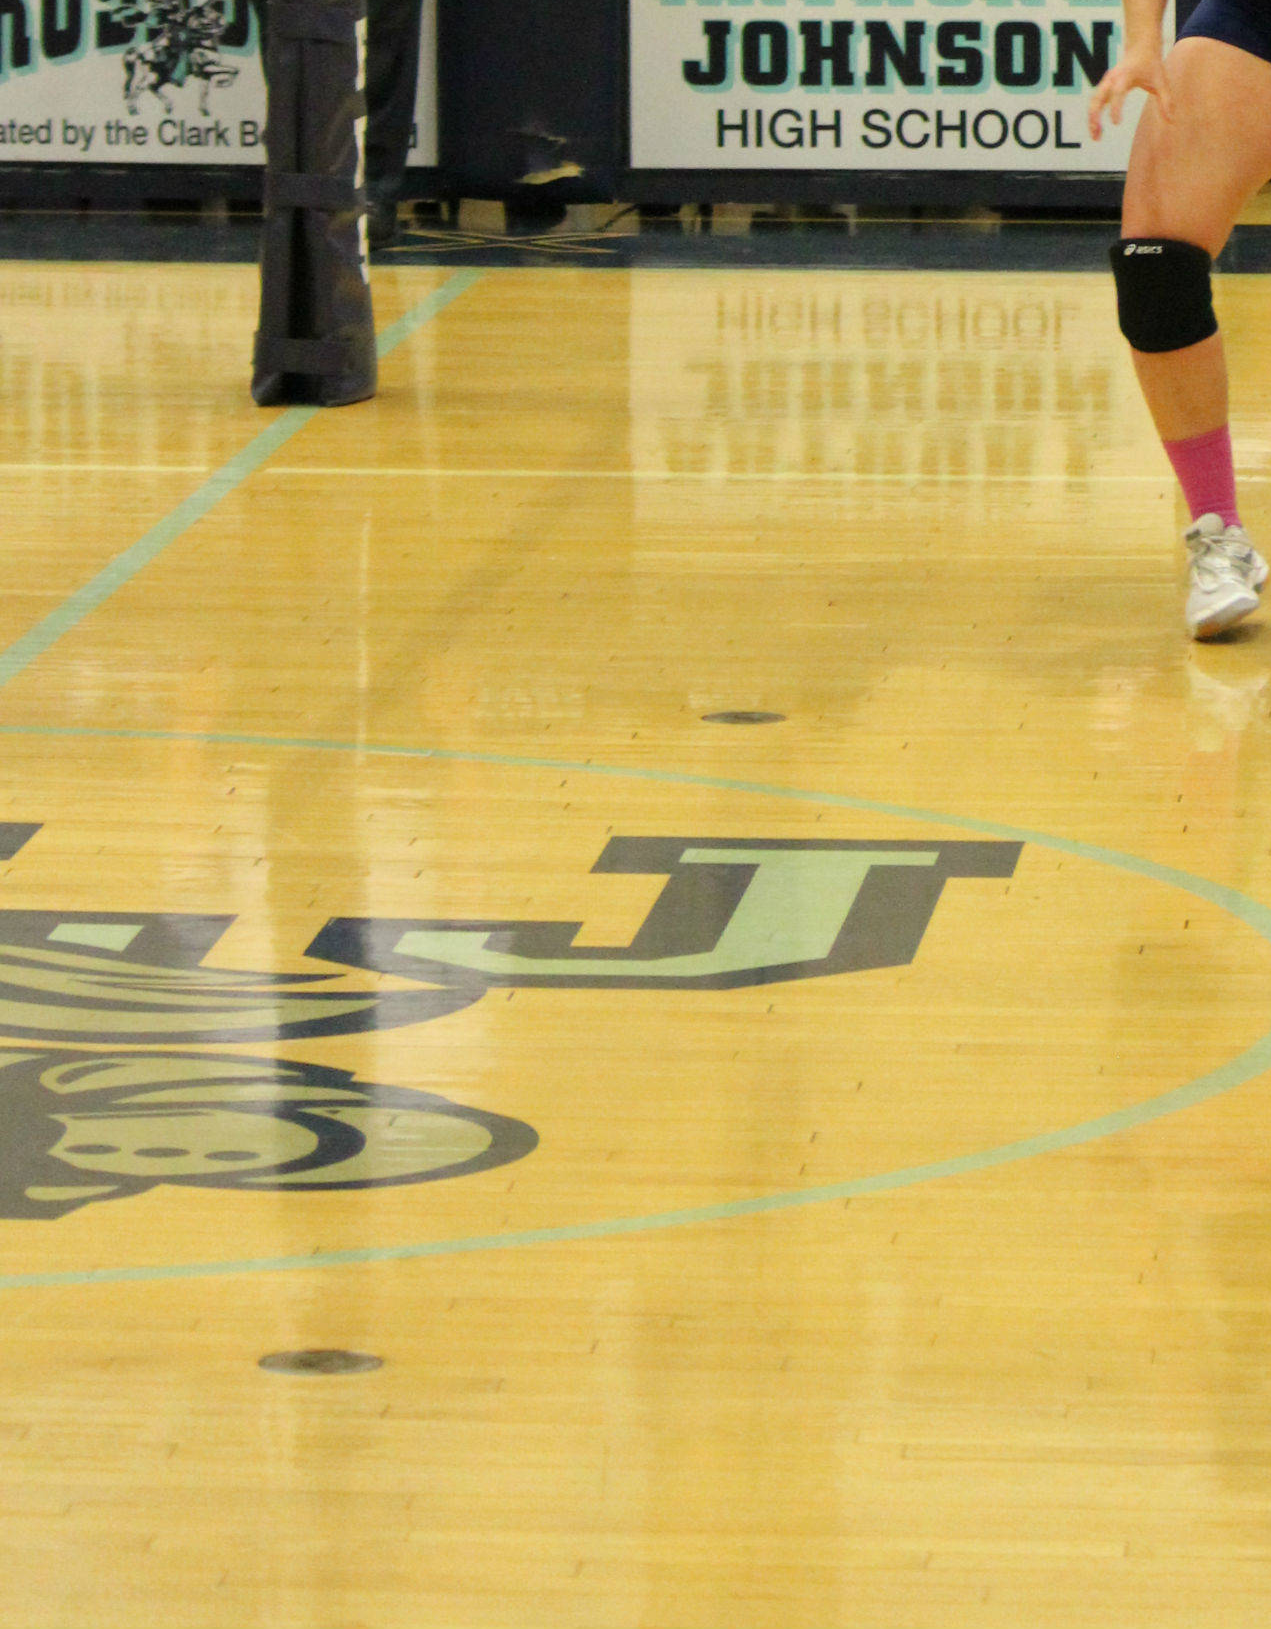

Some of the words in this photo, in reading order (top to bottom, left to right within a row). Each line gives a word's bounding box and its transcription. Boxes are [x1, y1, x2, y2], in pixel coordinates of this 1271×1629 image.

[682, 20, 1120, 93] JOHNSON
[62, 119, 96, 152] by
[104, 120, 148, 146] the
[157, 120, 230, 147] Clark
[716, 109, 842, 148] HIGH
[860, 109, 1082, 149] SCHOOL
